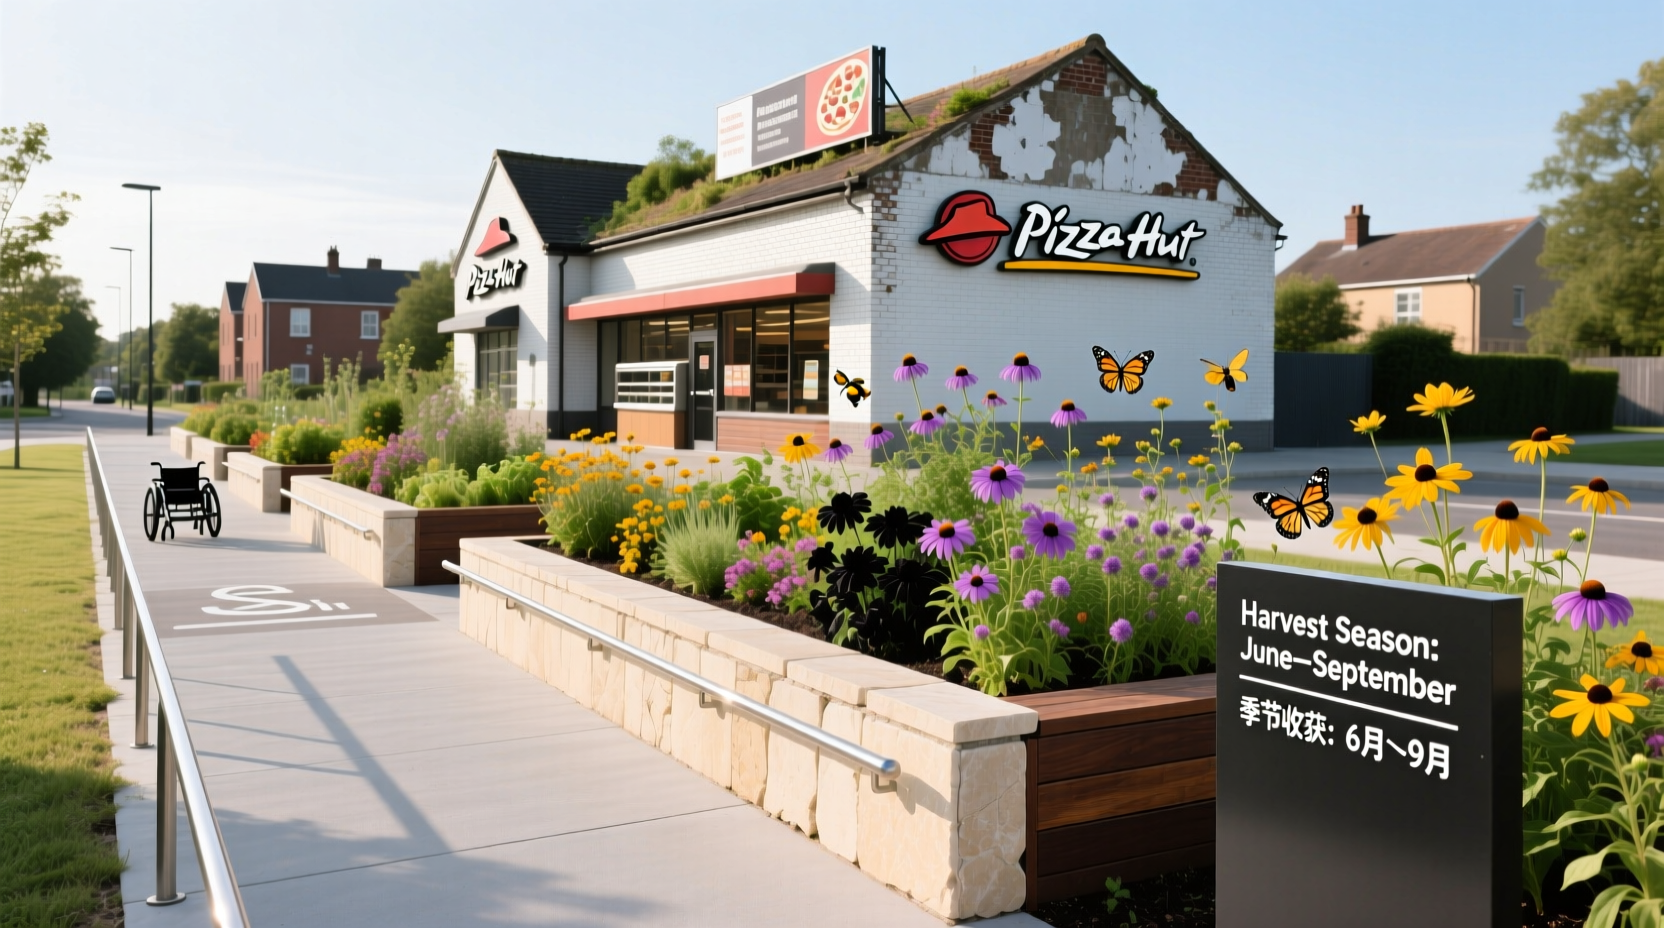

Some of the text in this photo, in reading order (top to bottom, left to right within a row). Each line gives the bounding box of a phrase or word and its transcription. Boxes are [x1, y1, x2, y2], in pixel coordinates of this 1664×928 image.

[1013, 202, 1206, 261] Pizza Hut
[1241, 598, 1439, 662] Harvest Season:
